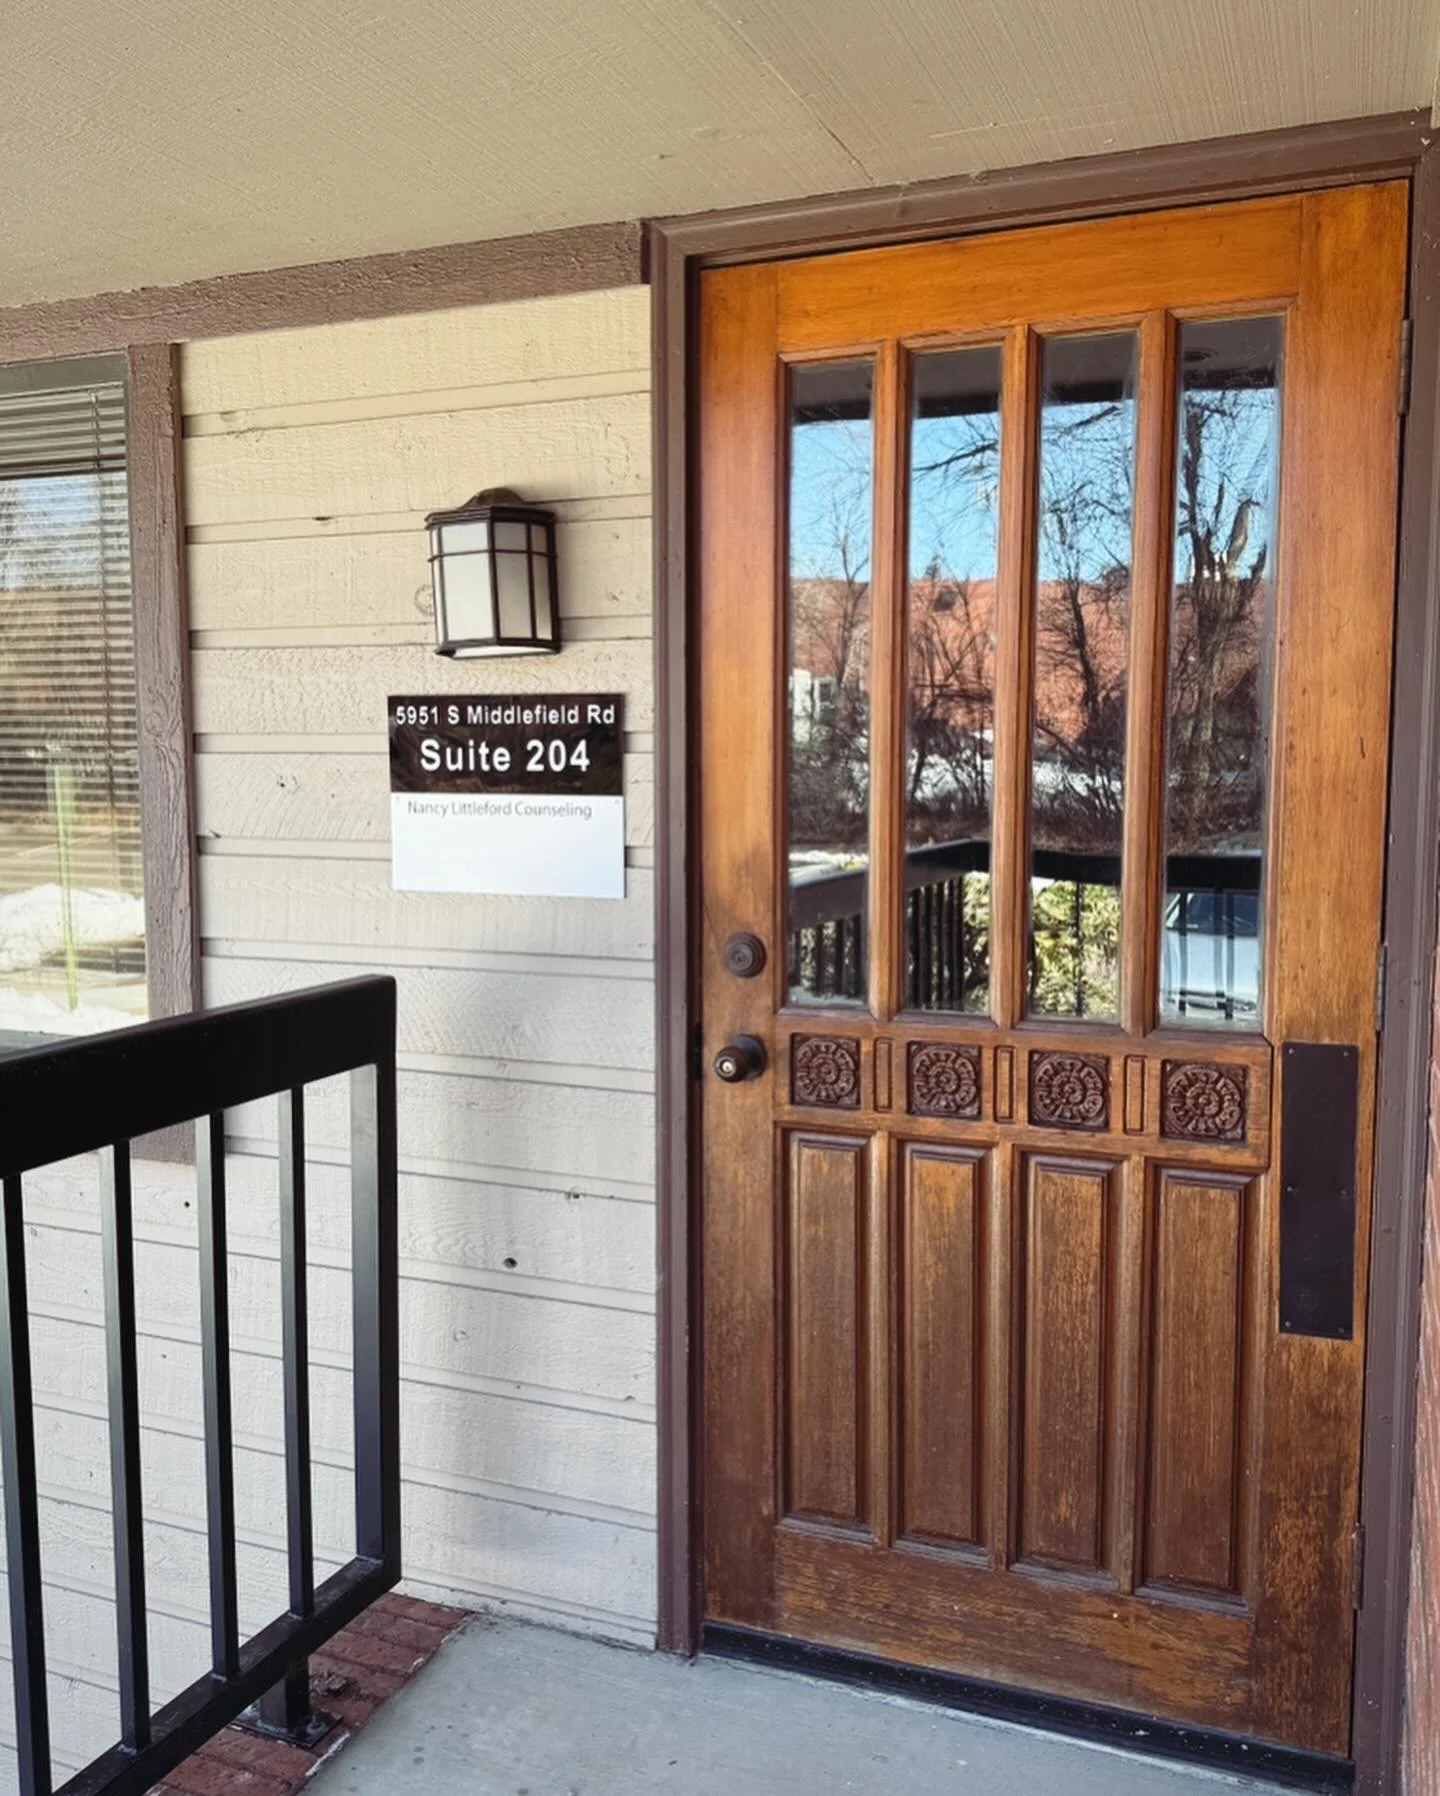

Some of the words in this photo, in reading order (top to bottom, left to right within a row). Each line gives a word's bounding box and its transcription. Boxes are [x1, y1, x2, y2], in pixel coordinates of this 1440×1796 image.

[396, 705, 439, 725] 5951
[447, 705, 460, 724] S
[467, 705, 579, 724] Middlefield
[587, 704, 615, 724] Rd
[420, 738, 511, 772] Suite
[526, 739, 590, 772] 204
[408, 801, 449, 817] Nancy
[452, 801, 512, 816] Littleford
[515, 802, 592, 819] Counseling
